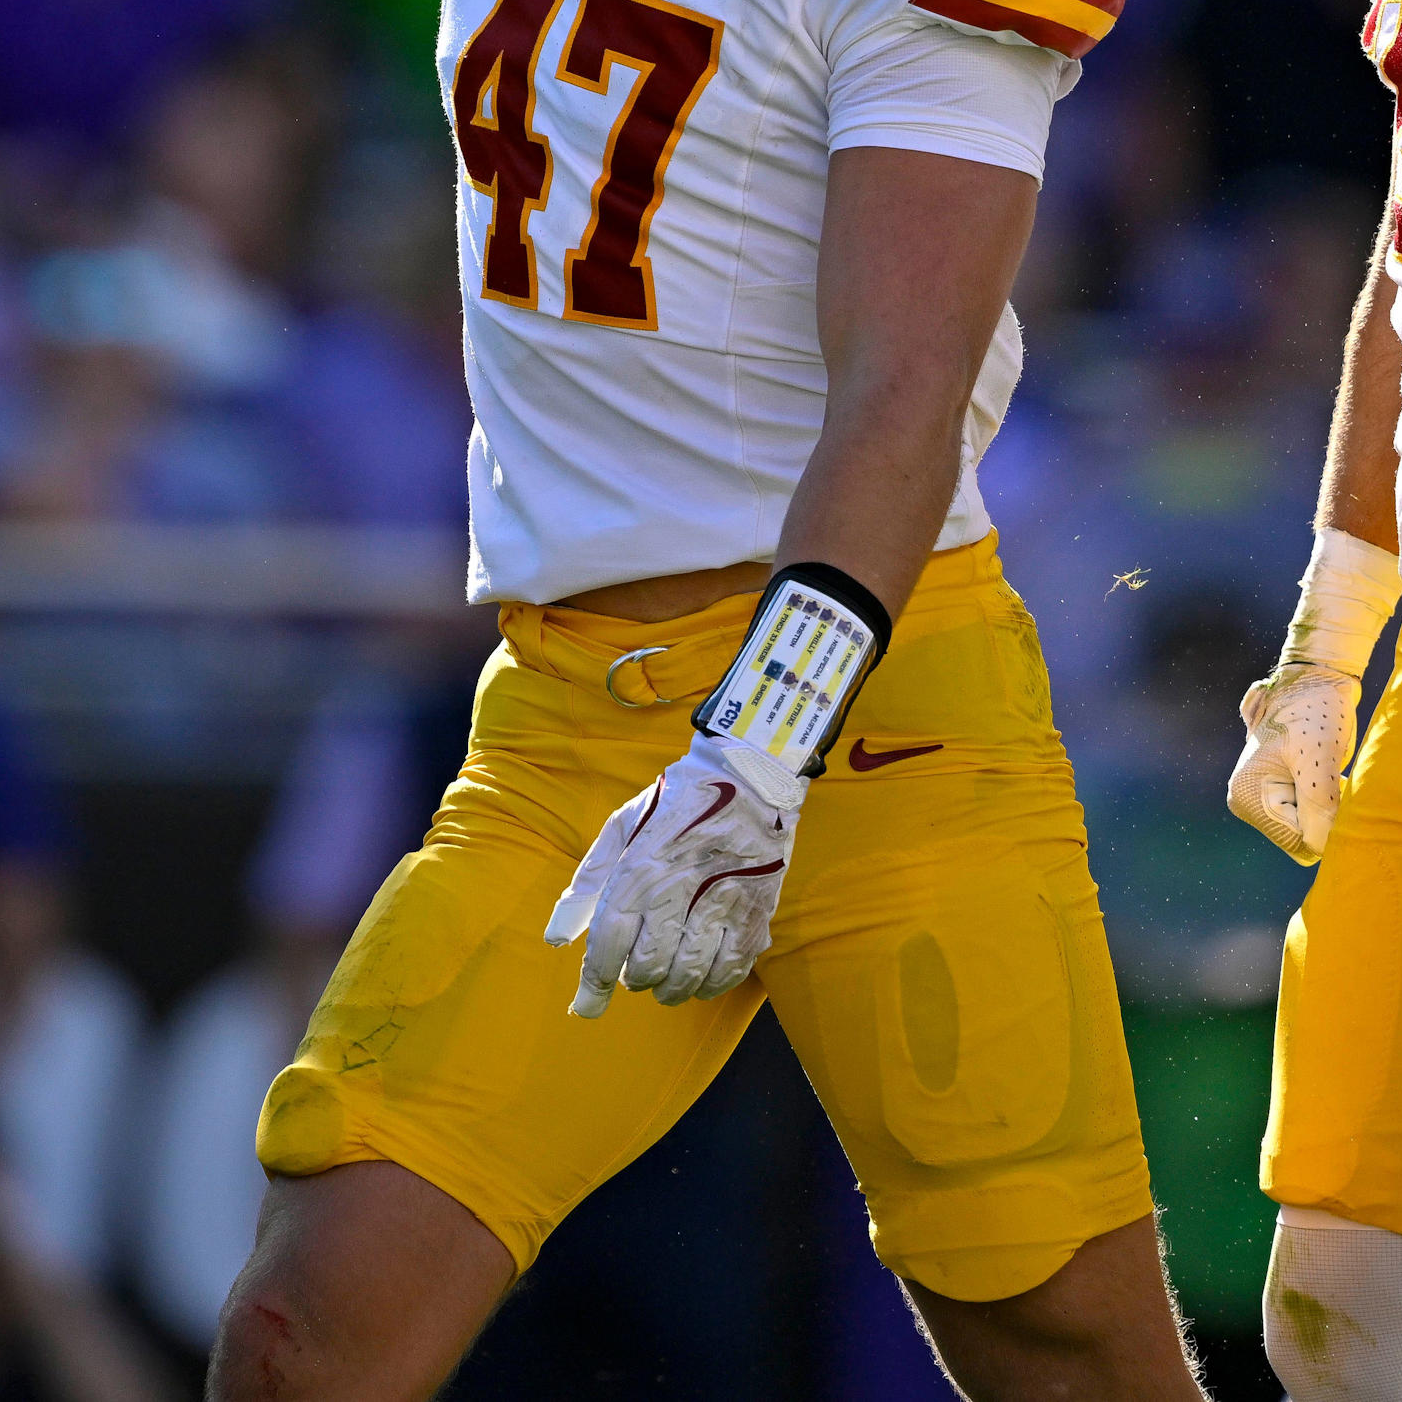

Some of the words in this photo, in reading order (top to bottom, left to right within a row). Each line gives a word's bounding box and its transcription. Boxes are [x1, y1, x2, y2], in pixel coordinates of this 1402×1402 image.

[774, 613, 789, 633] PINCH
[790, 622, 806, 648] BOSTON
[770, 633, 778, 642] 33
[808, 631, 823, 655] PHILLY
[827, 639, 838, 656] NOSE
[758, 642, 772, 663] PRESS
[812, 655, 830, 680] SPECIAL
[751, 683, 767, 707] SMOKE
[773, 694, 786, 711] NOSE
[718, 699, 742, 730] TCU
[766, 710, 776, 725] SKY
[786, 703, 803, 727] STRIKE
[799, 714, 819, 745] MUSTANG
